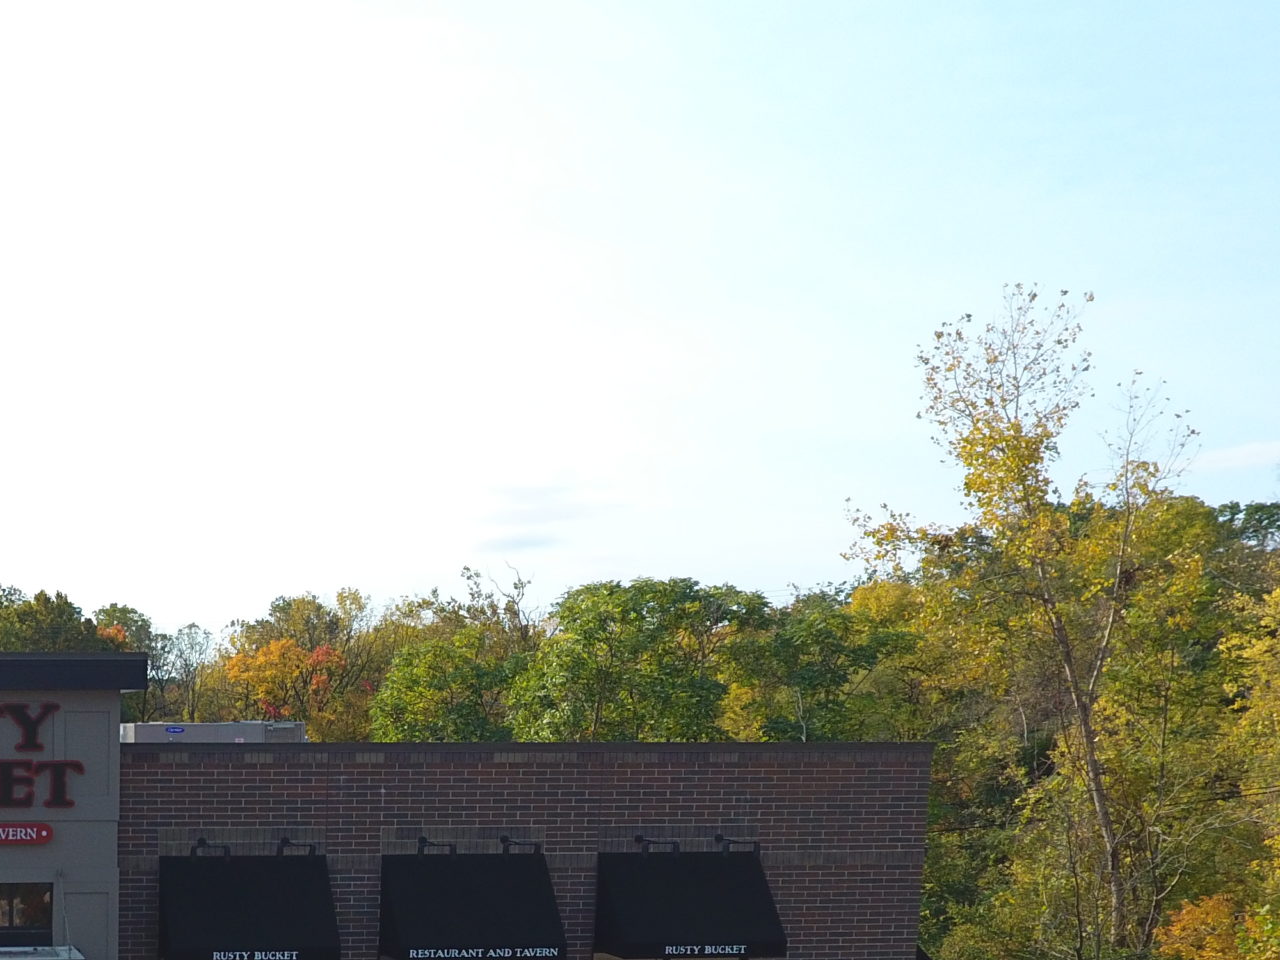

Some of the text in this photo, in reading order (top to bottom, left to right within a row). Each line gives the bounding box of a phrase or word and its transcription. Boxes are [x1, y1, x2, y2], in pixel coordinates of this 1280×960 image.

[410, 947, 560, 959] RESTAURANT AND TAVERN
[665, 945, 747, 955] RUSTY BUCKET
[213, 951, 299, 960] RUSTY BUCKET
